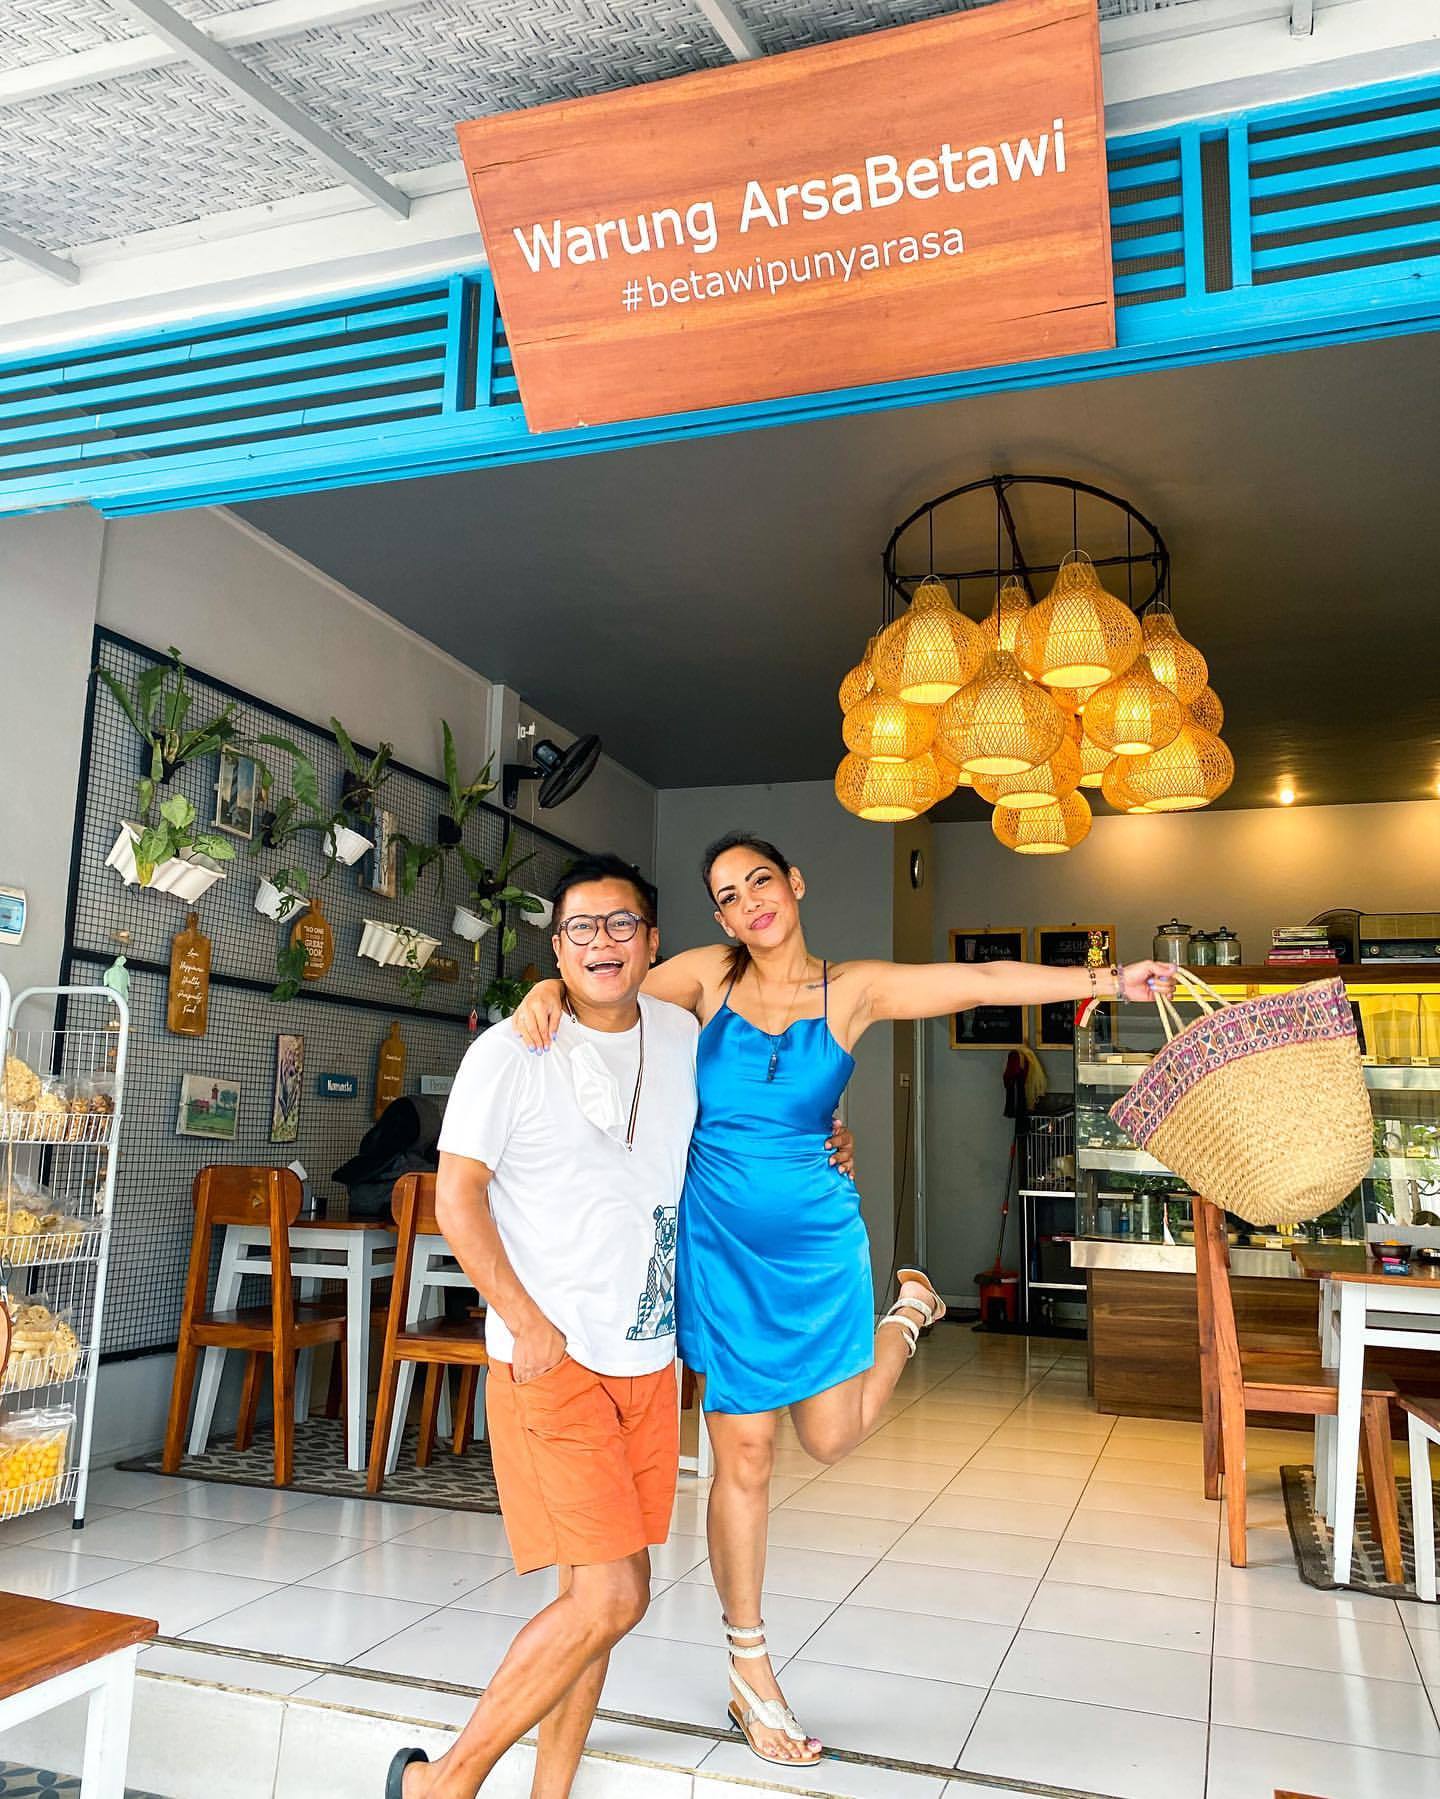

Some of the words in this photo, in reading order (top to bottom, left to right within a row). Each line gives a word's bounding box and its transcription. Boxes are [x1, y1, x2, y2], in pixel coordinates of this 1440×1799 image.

[513, 201, 718, 273] Warung
[740, 118, 1067, 233] ArsaBetawi
[622, 228, 965, 313] #betawipunyarasa
